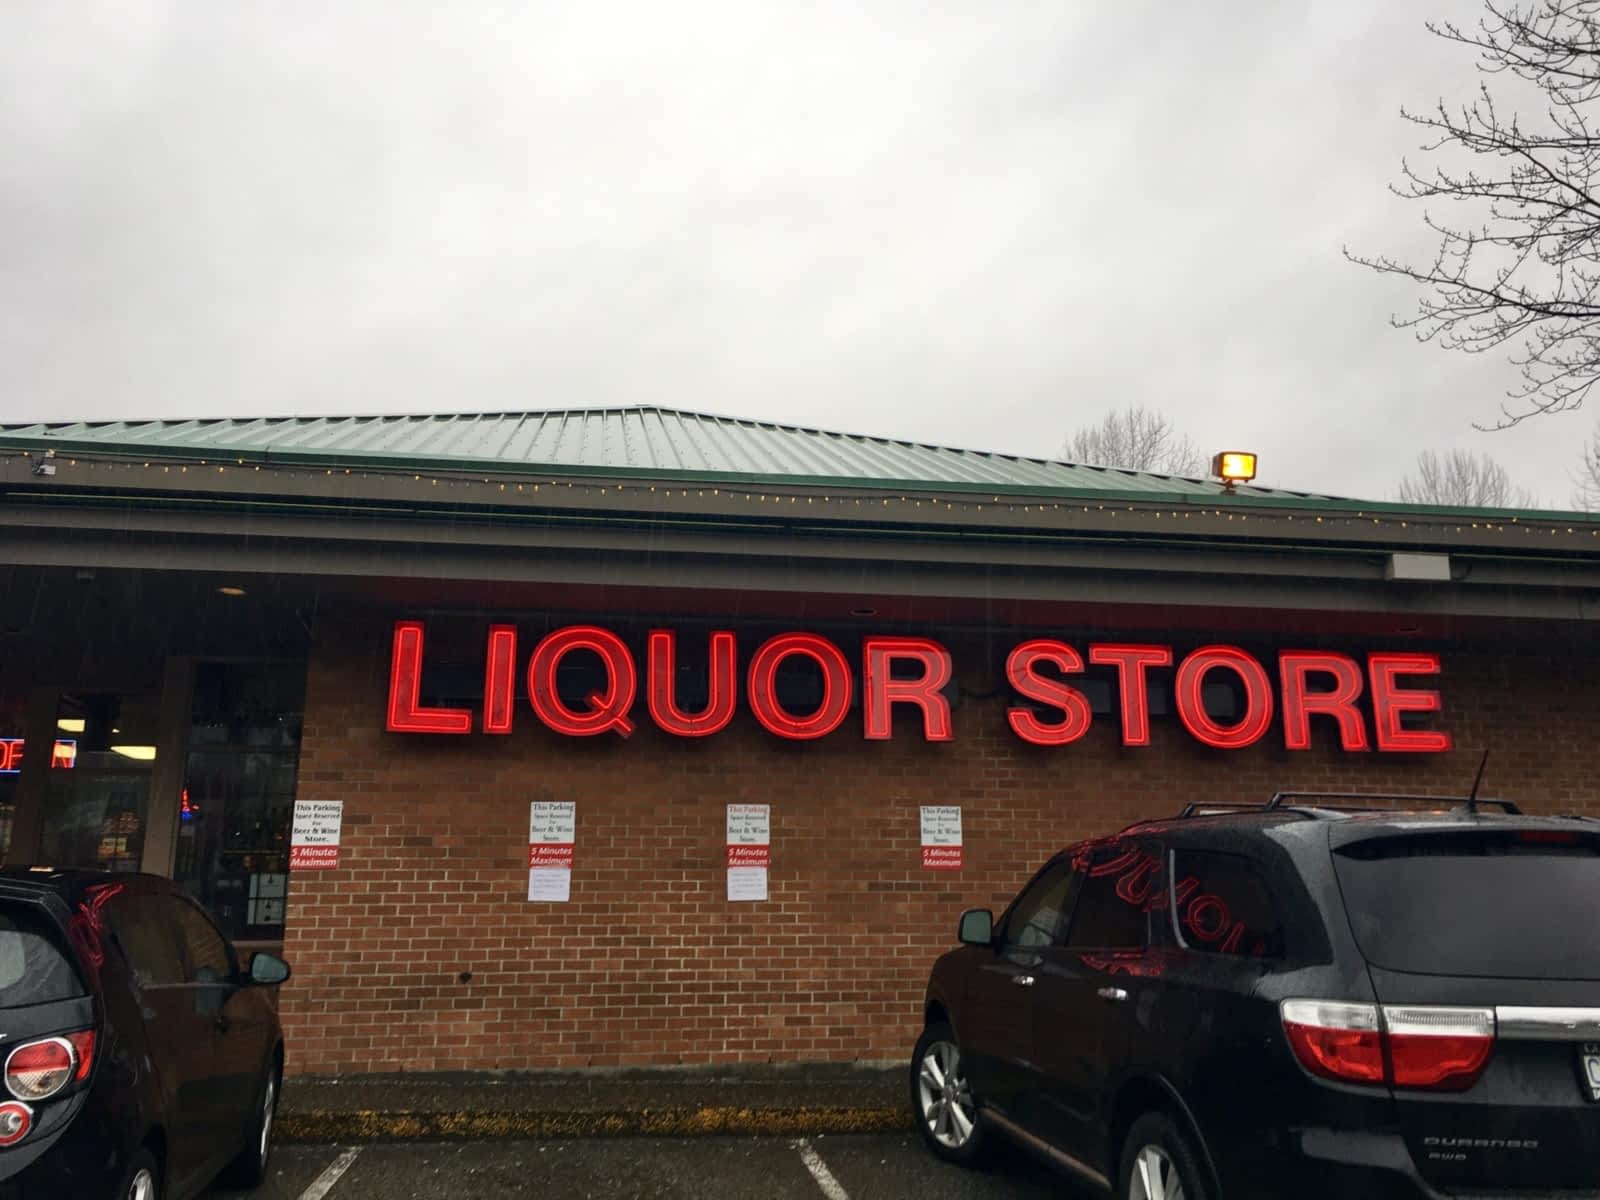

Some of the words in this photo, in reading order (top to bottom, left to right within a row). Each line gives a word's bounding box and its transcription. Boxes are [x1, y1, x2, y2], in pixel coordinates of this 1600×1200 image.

[386, 620, 955, 741] LIQUOR
[1006, 639, 1452, 753] STORE
[313, 804, 341, 812] Parking
[549, 803, 574, 811] Parking
[743, 806, 768, 814] Parking
[291, 847, 298, 857] 5
[300, 847, 338, 857] Minutes
[531, 847, 536, 855] 5
[538, 847, 572, 855] Minutes
[728, 848, 734, 856] 5
[735, 848, 768, 857] Minutes
[923, 849, 929, 857] 5
[930, 849, 961, 857] Minutes
[290, 858, 337, 867] Maximum
[530, 857, 572, 865] Maximum
[923, 858, 961, 866] Maximum
[1423, 1136, 1539, 1148] DURANGO
